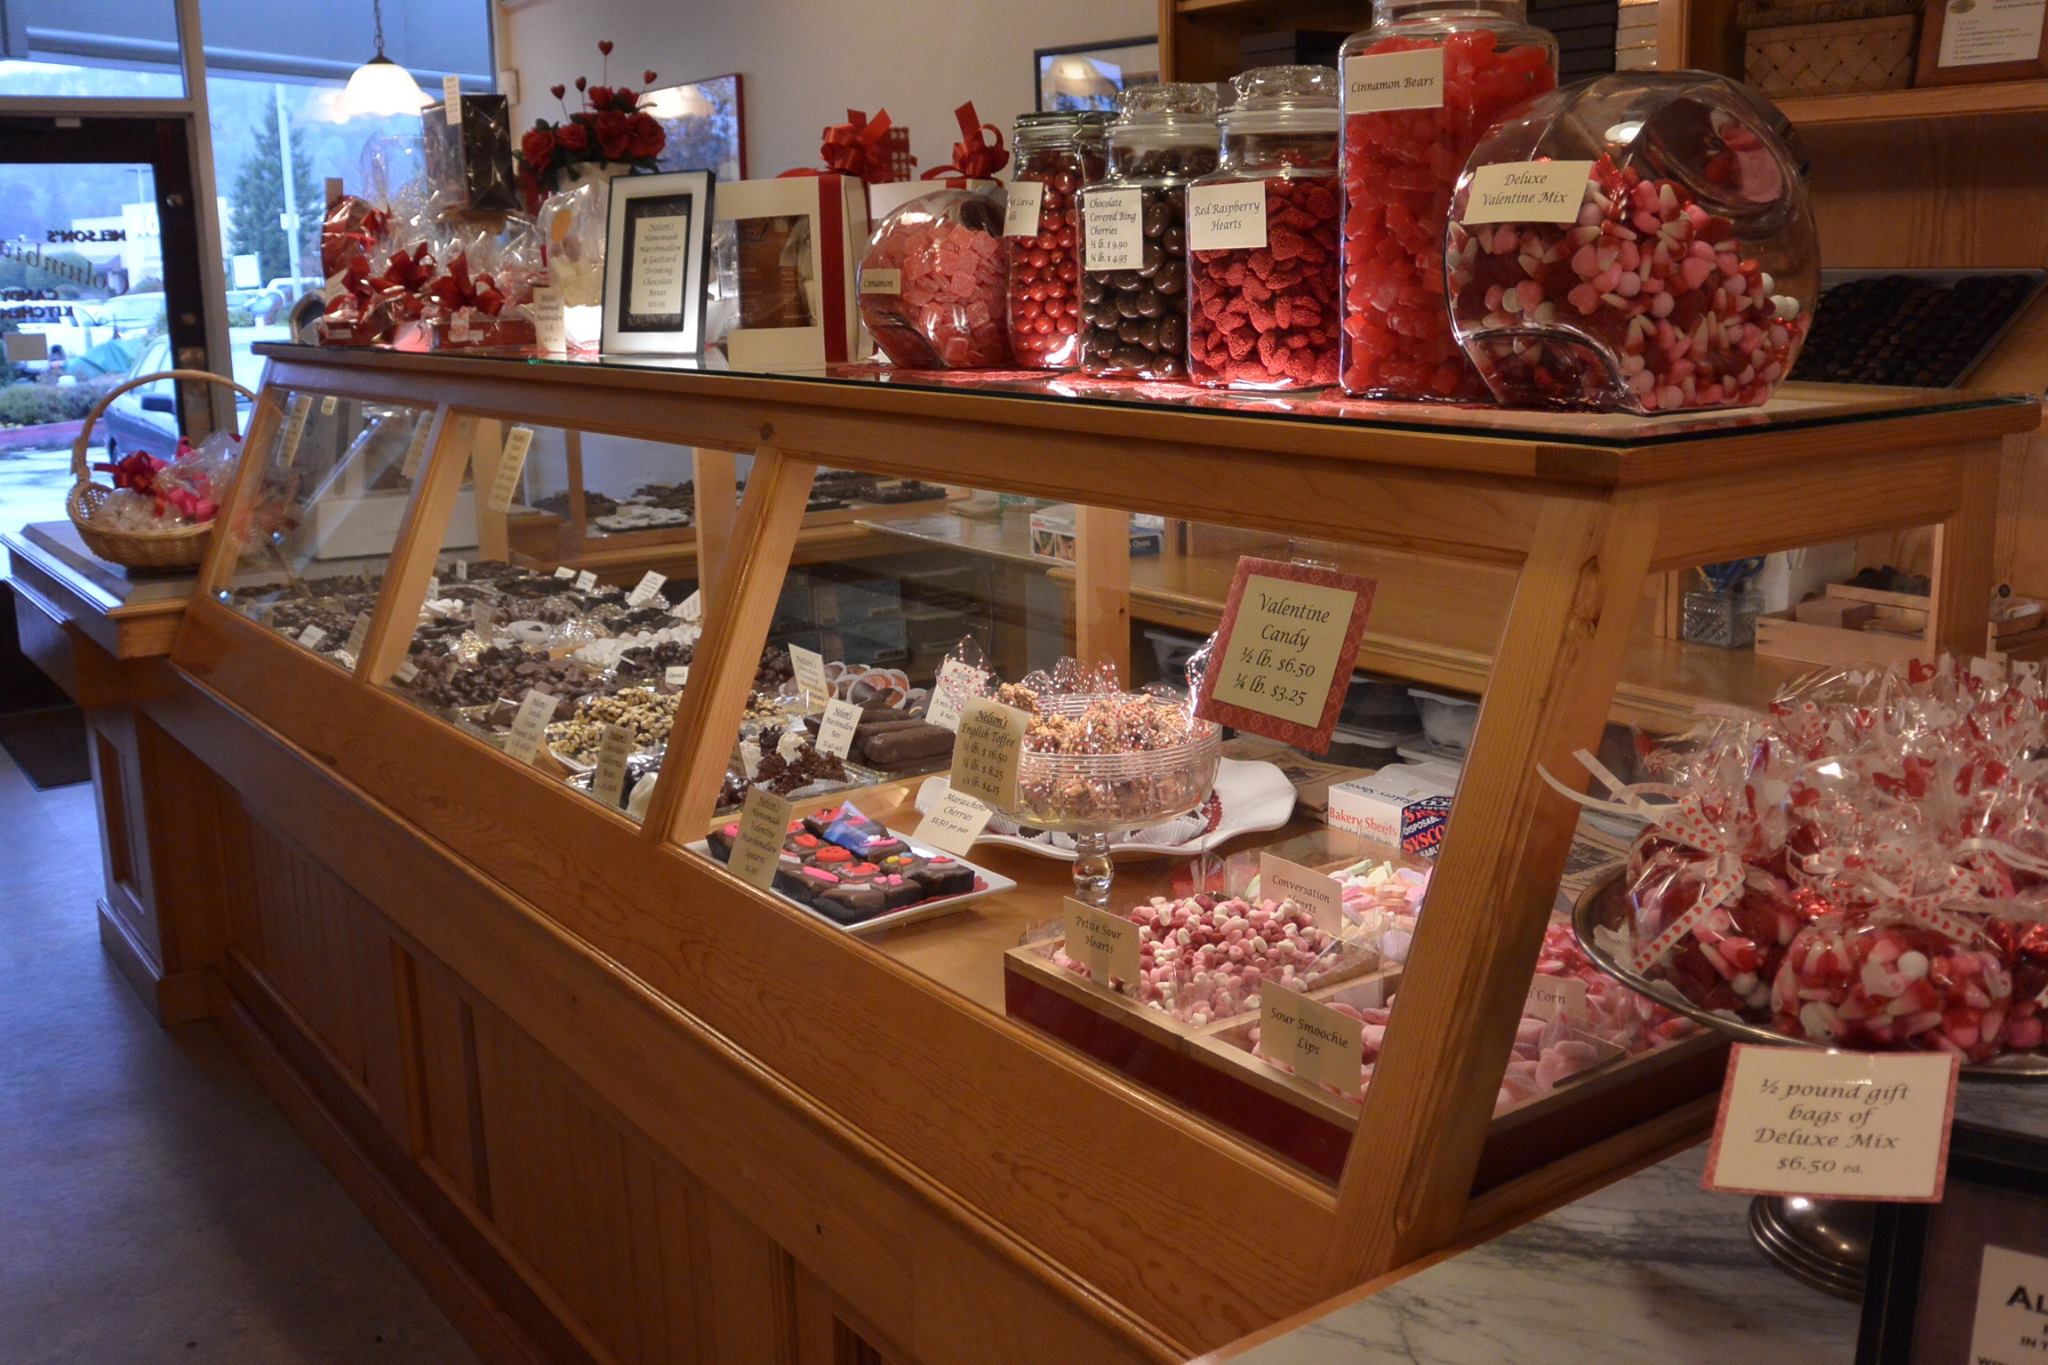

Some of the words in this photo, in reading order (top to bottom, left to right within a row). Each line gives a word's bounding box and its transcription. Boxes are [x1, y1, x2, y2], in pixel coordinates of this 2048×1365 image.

[1351, 80, 1401, 93] Cinnamon
[1403, 77, 1435, 89] Bears
[1503, 171, 1548, 187] Deluxe
[1089, 196, 1123, 209] Chocolate
[1194, 205, 1211, 217] Red
[1211, 199, 1261, 217] Raspberry
[1482, 191, 1536, 206] Valentine
[1537, 190, 1568, 204] Mix
[1089, 211, 1118, 223] Covered
[1119, 210, 1137, 224] Bing
[1210, 219, 1243, 232] Hearts
[1089, 226, 1118, 237] Cherries
[1259, 593, 1331, 624] Valentine
[1260, 624, 1311, 654] Candy
[1256, 649, 1273, 669] lb.
[1277, 657, 1317, 679] $6.50
[1249, 675, 1266, 695] lb.
[1270, 684, 1308, 706] $3.25
[975, 710, 1009, 730] Nelson's
[961, 723, 991, 740] English
[990, 731, 1016, 749] Toffee
[943, 792, 987, 813] Maraschino
[943, 806, 975, 822] Cherries
[1329, 806, 1362, 829] Bakery
[1364, 817, 1398, 837] Sheets
[1402, 824, 1446, 855] SYSCO
[1271, 873, 1331, 904] Conversation
[1075, 915, 1100, 933] Petite
[1101, 924, 1123, 941] Sour
[1084, 934, 1114, 955] Hearts
[1536, 990, 1566, 1005] Corn
[1270, 1006, 1296, 1026] Sour
[1297, 1017, 1350, 1049] Smoochie
[1296, 1036, 1321, 1056] Lips
[1778, 1082, 1864, 1101] pound
[1863, 1081, 1911, 1107] gift
[1787, 1103, 1843, 1129] bags
[1849, 1106, 1879, 1130] of
[1754, 1126, 1840, 1149] Deluxe
[1845, 1132, 1902, 1150] Mix
[1776, 1155, 1838, 1175] $6.50
